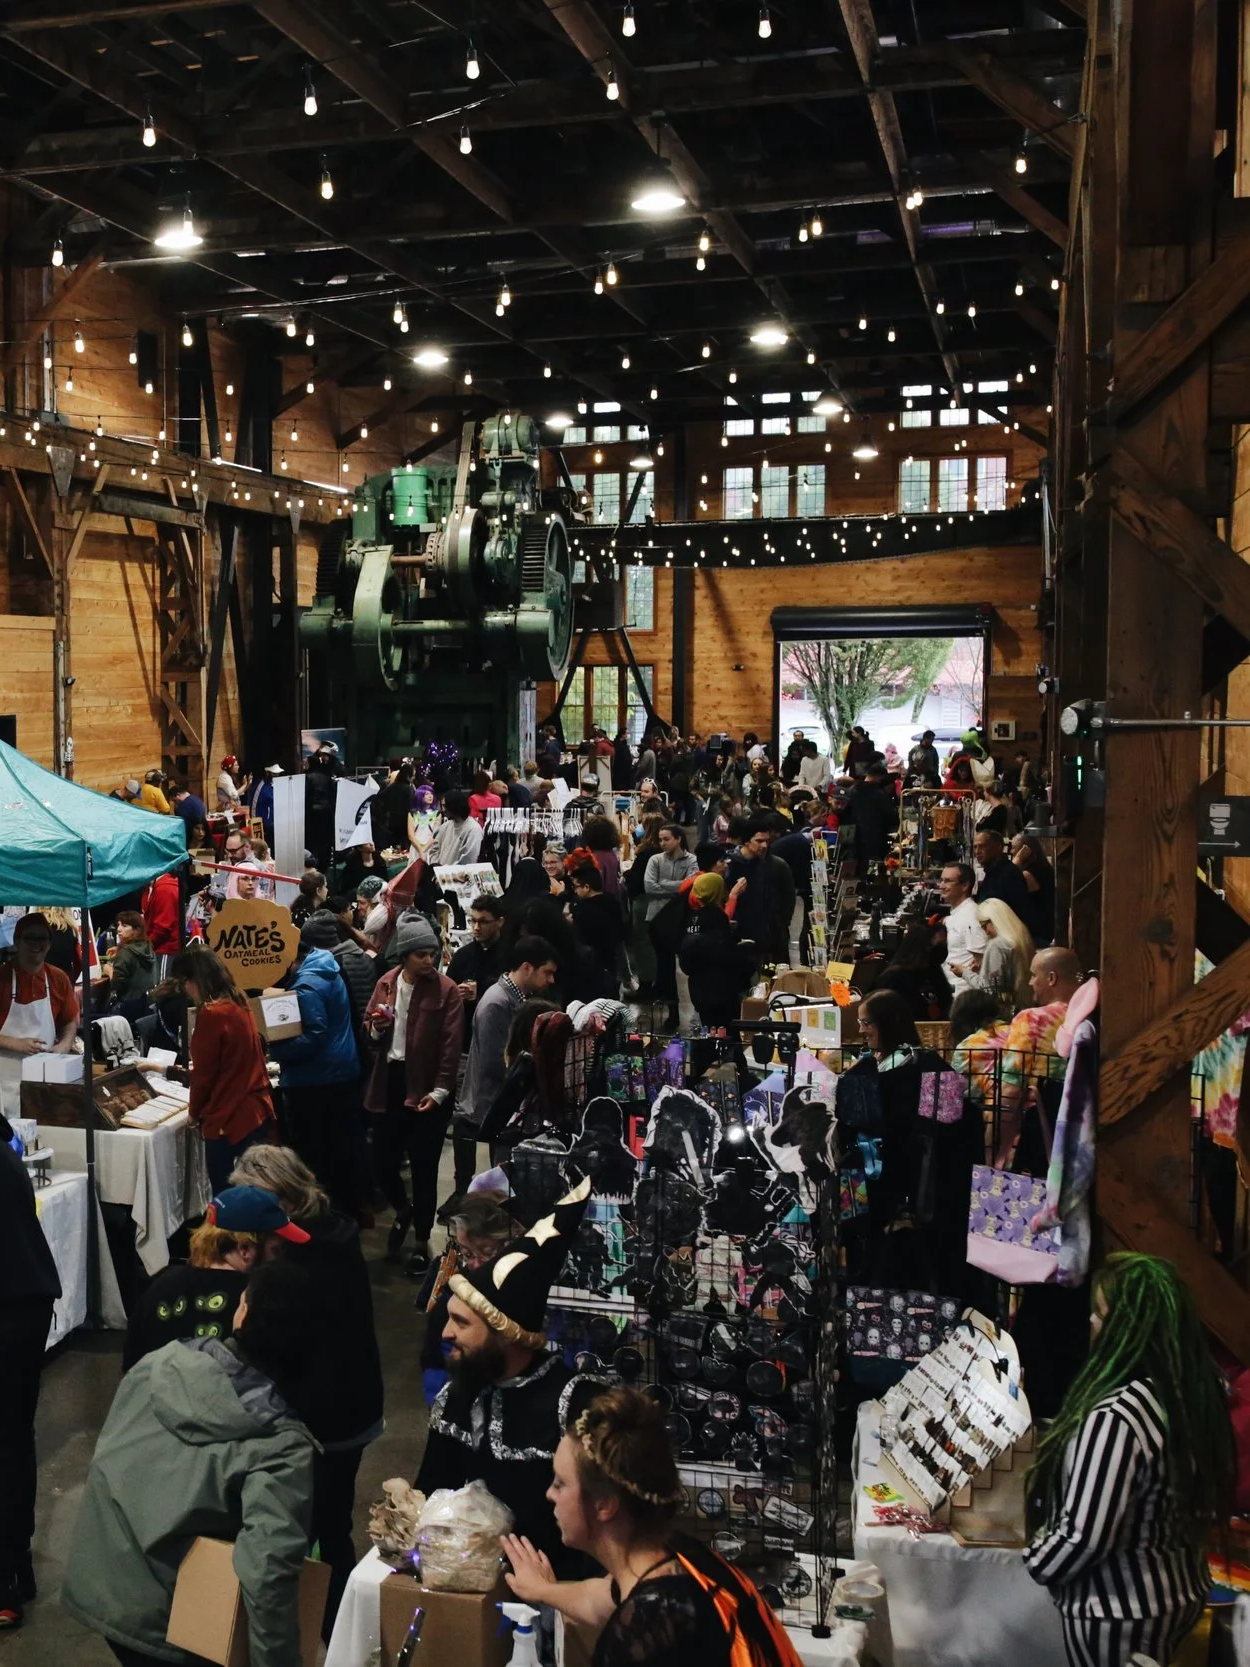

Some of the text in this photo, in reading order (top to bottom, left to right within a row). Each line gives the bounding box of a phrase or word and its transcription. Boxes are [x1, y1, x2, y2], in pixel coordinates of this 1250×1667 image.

[213, 920, 285, 952] NATE'S
[224, 950, 270, 959] OATMEAL
[241, 955, 282, 967] COOKIES
